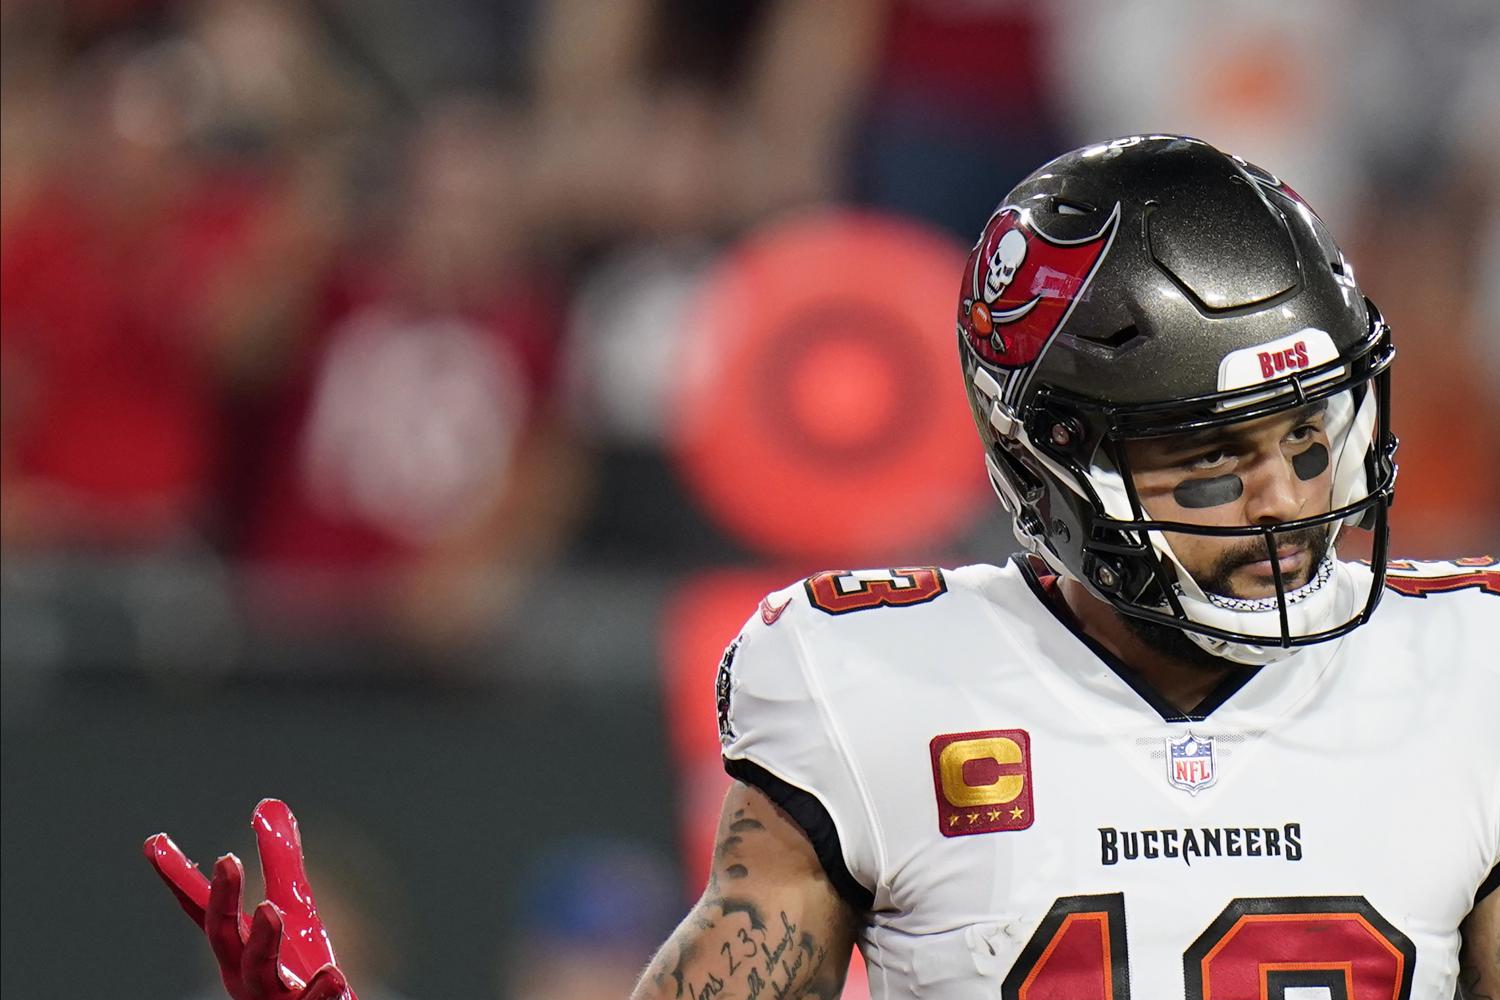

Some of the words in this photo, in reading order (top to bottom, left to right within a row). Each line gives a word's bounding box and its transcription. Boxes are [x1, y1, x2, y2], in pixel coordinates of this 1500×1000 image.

[939, 737, 1024, 808] C
[1175, 759, 1211, 783] NFL
[1098, 823, 1303, 867] BUCCANEERS
